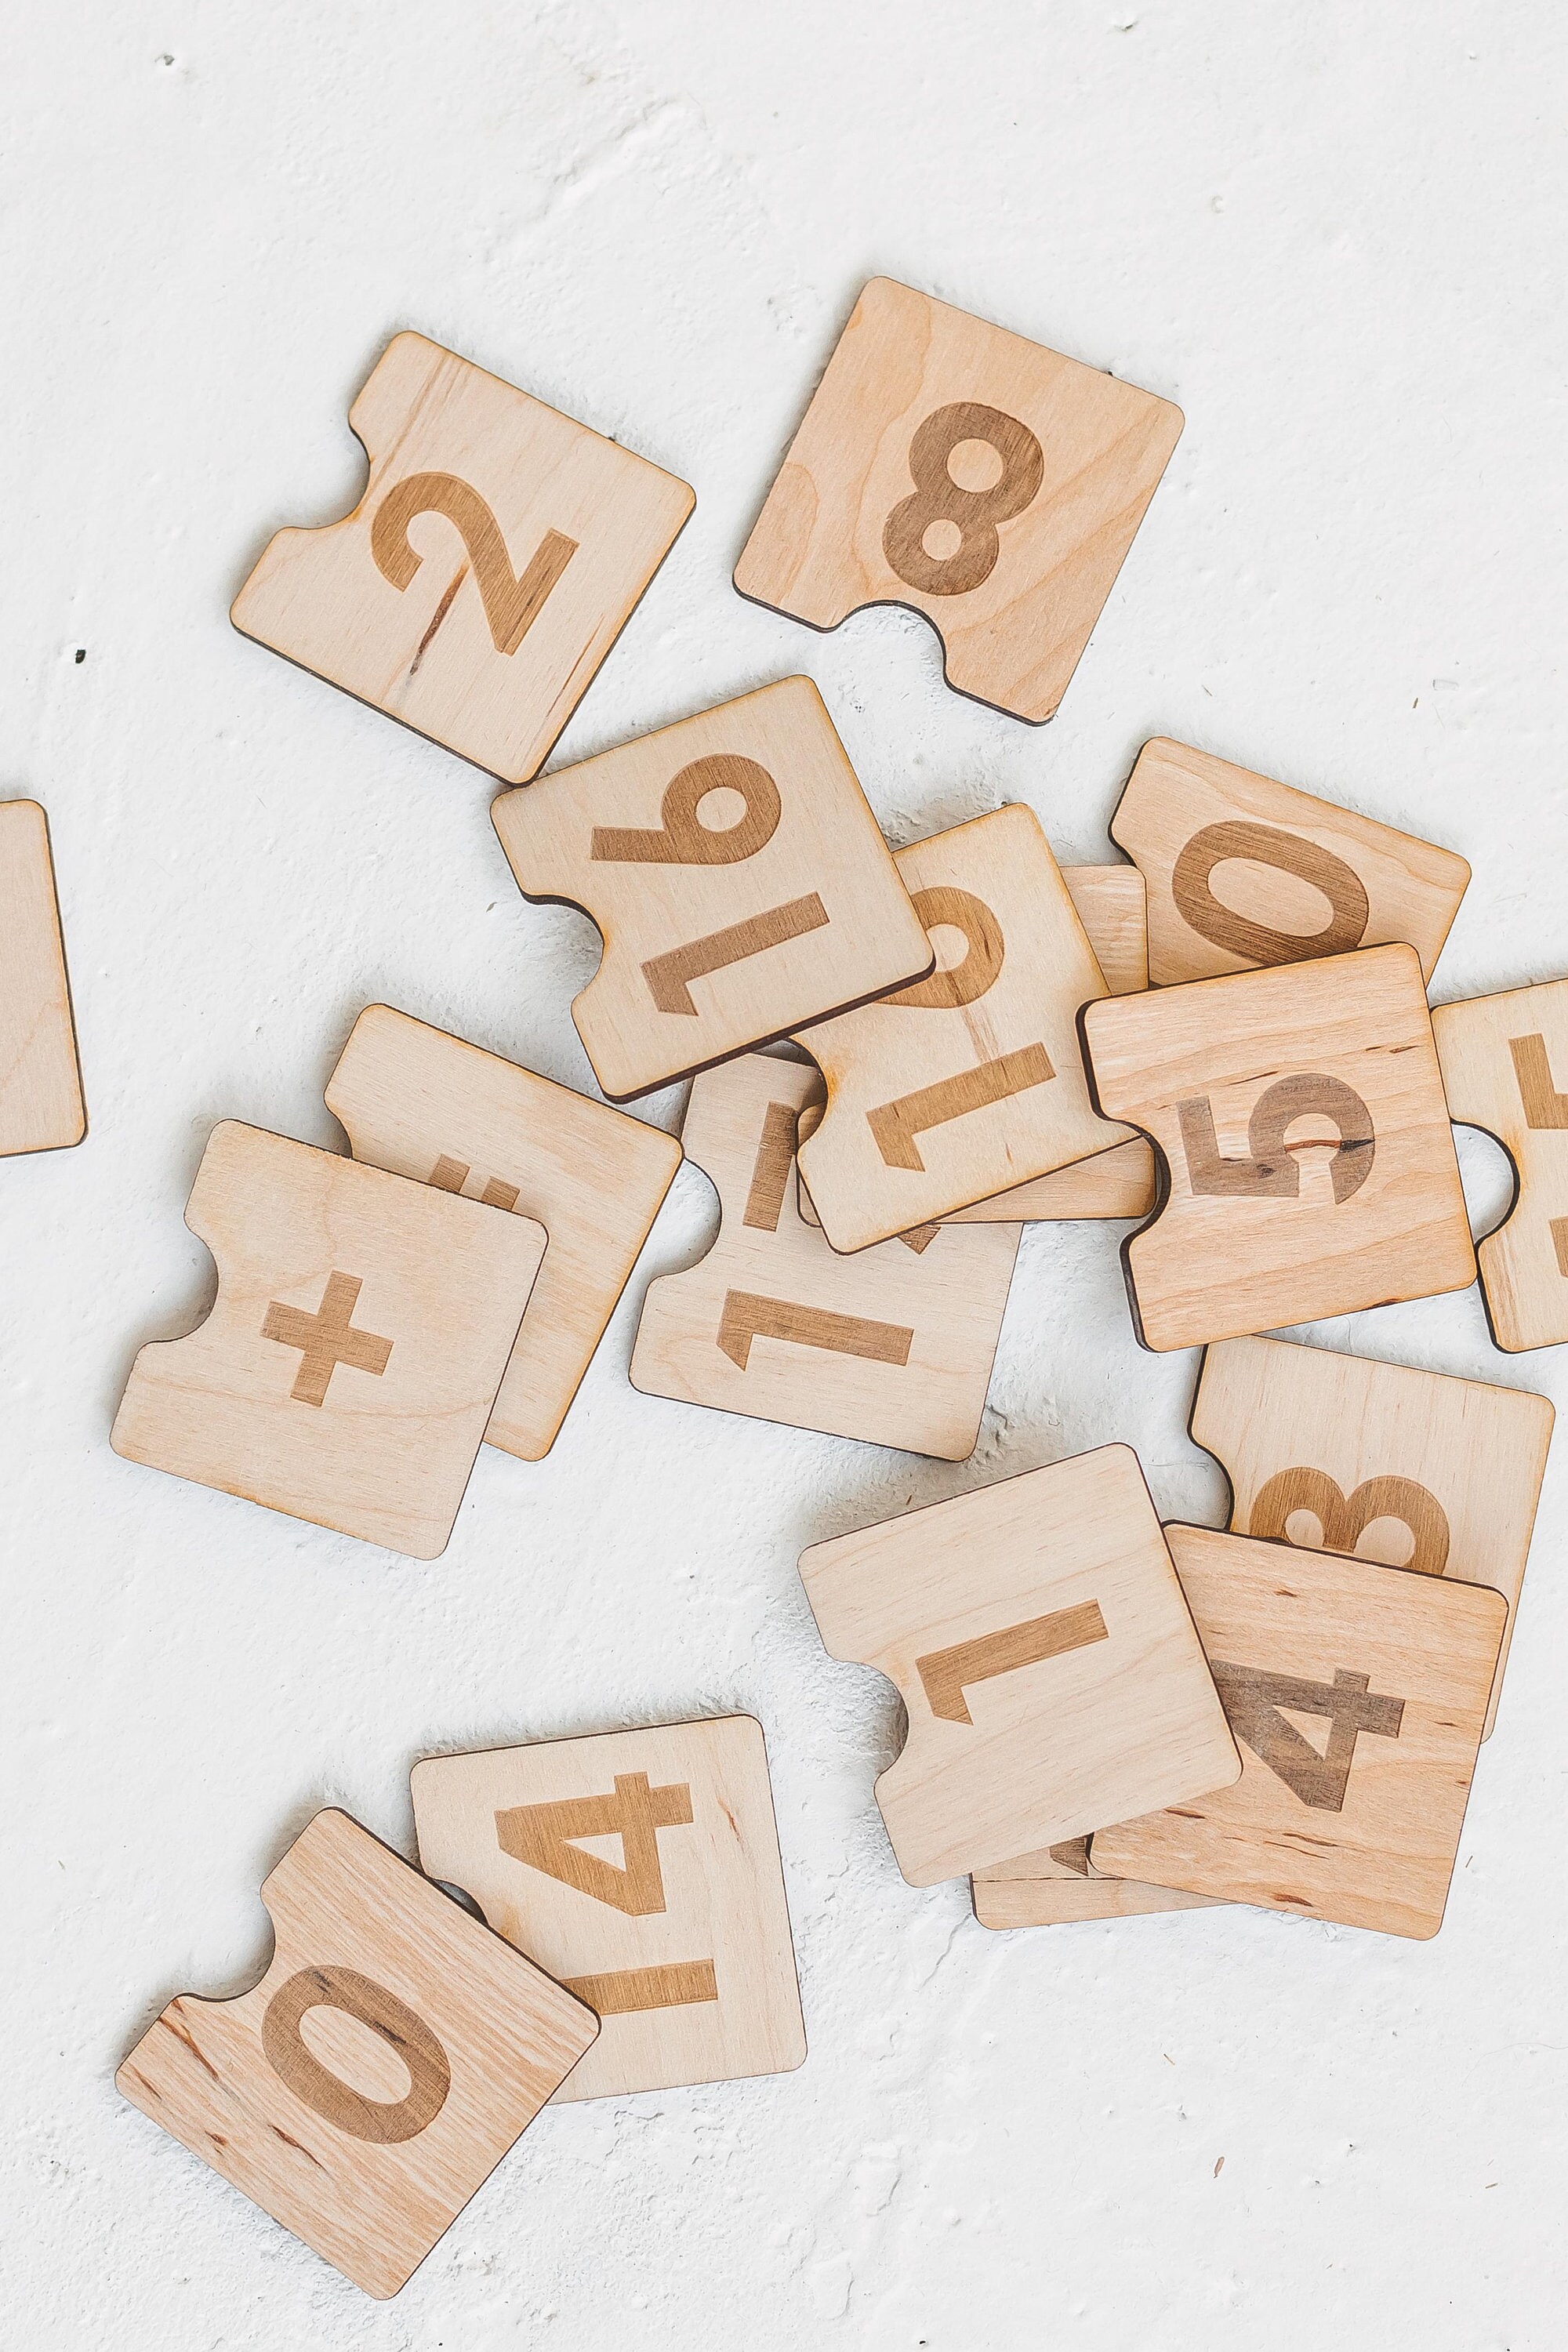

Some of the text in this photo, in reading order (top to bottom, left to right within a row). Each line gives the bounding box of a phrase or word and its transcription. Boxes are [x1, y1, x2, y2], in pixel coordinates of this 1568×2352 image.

[370, 471, 580, 657] 2
[882, 401, 1044, 596] 8
[590, 753, 829, 1017] 16
[1174, 1073, 1376, 1206] 5
[916, 1599, 1109, 1725] 1
[1214, 1660, 1405, 1813] 4
[261, 1964, 452, 2145] 0
